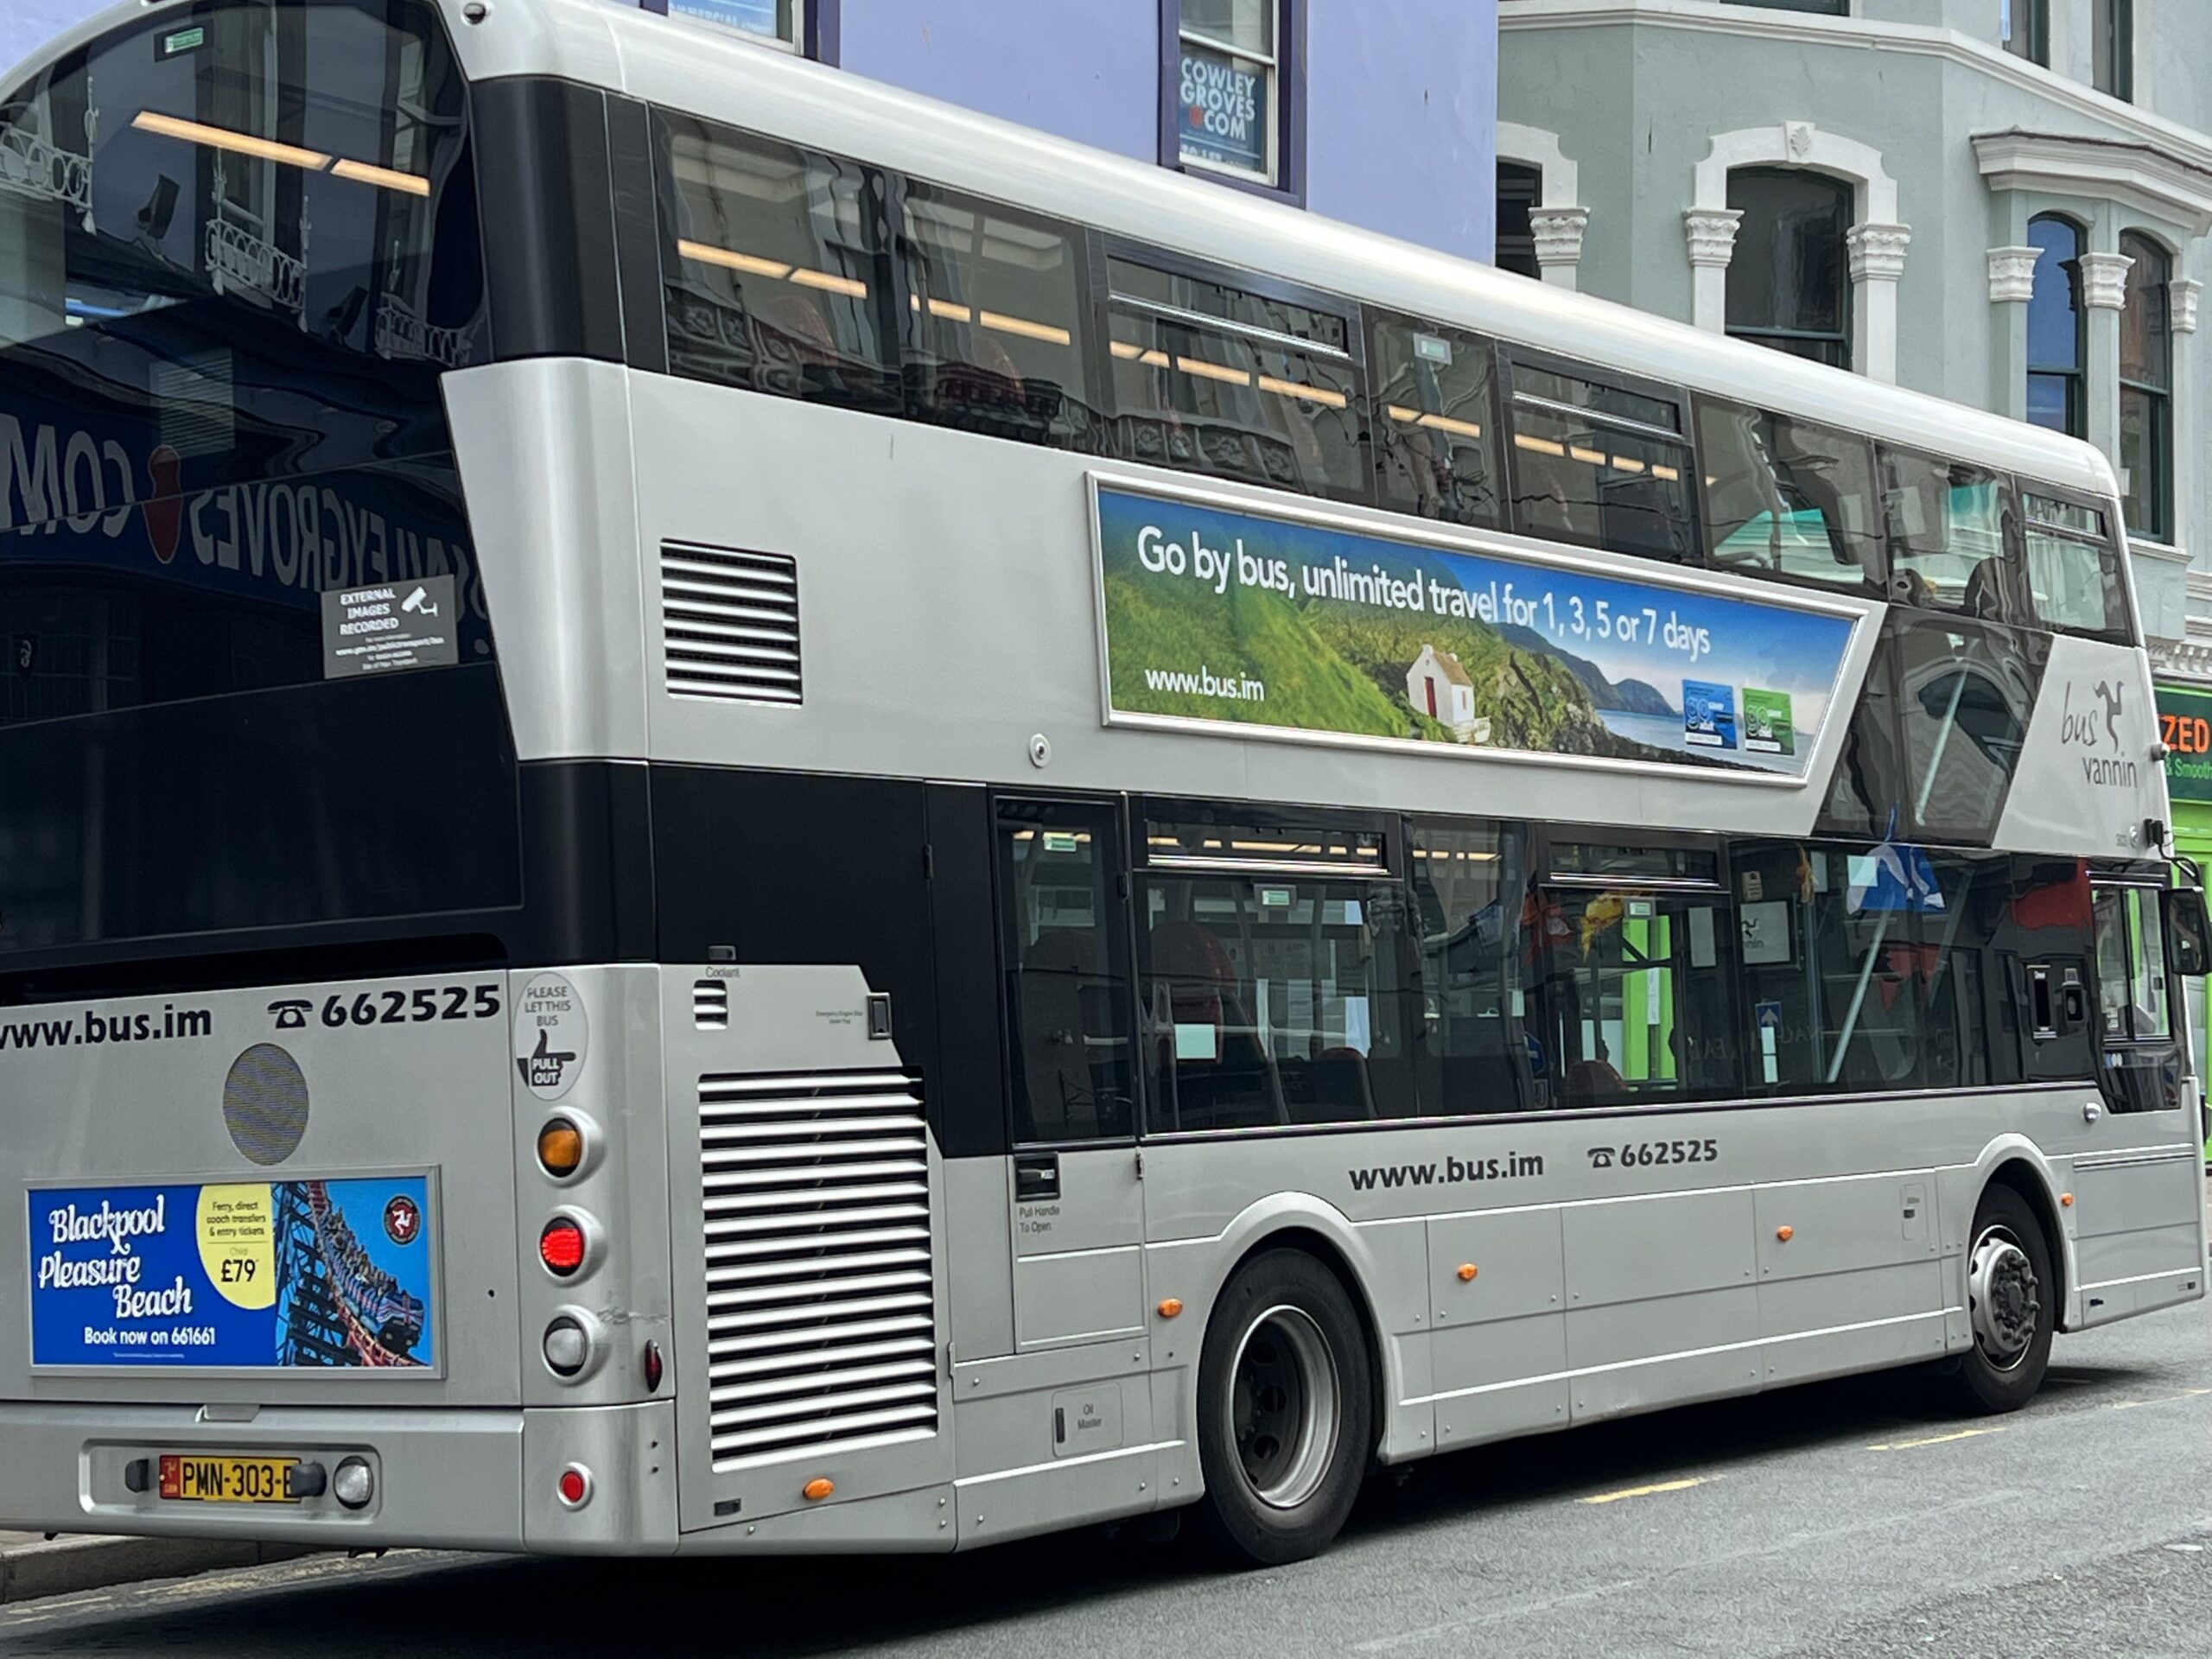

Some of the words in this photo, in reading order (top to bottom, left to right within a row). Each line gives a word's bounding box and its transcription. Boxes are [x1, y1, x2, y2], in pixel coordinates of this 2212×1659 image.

[1181, 57, 1255, 98] COWLEY
[1180, 81, 1255, 121] GROVES
[340, 588, 397, 605] EXTERNAL
[1137, 525, 1186, 575] Go
[1192, 531, 1230, 594] by
[1236, 538, 1295, 598] bus,
[1302, 556, 1424, 612] unlimited
[1429, 578, 1498, 624] travel
[1503, 582, 1537, 627] for
[1595, 601, 1612, 639] 5
[1617, 618, 1640, 643] or
[1641, 608, 1658, 645] 7
[1663, 611, 1712, 663] days
[347, 604, 391, 619] IMAGES
[340, 618, 399, 635] RECORDED
[1144, 666, 1265, 701] www.bus.im
[2062, 681, 2098, 747] bus
[2082, 751, 2139, 789] vannin
[706, 966, 741, 978] Coolant
[527, 987, 568, 998] PLEASE
[525, 1001, 544, 1013] LET
[545, 1001, 571, 1012] THIS
[0, 1003, 212, 1050] ww.bus.im
[321, 984, 501, 1028] 662525
[537, 1015, 559, 1027] BUS
[532, 1058, 560, 1070] PULL
[534, 1072, 558, 1084] OUT
[1348, 1151, 1544, 1192] www.bus.im
[1620, 1139, 1719, 1169] 662525
[235, 1201, 258, 1211] direct
[1020, 1206, 1033, 1217] Pull
[1034, 1205, 1060, 1217] Handle
[49, 1194, 166, 1255] Blackpool
[207, 1215, 230, 1224] coach
[232, 1213, 266, 1223] transfers
[217, 1228, 237, 1237] entry
[238, 1227, 264, 1236] tickets
[1020, 1222, 1030, 1233] To
[1032, 1221, 1052, 1234] Open
[229, 1247, 248, 1255] Child
[38, 1252, 141, 1289] Pleasure
[112, 1275, 194, 1319] Beach
[84, 1326, 118, 1344] Book
[119, 1331, 148, 1344] now
[150, 1331, 168, 1344] on
[171, 1326, 216, 1345] 661661
